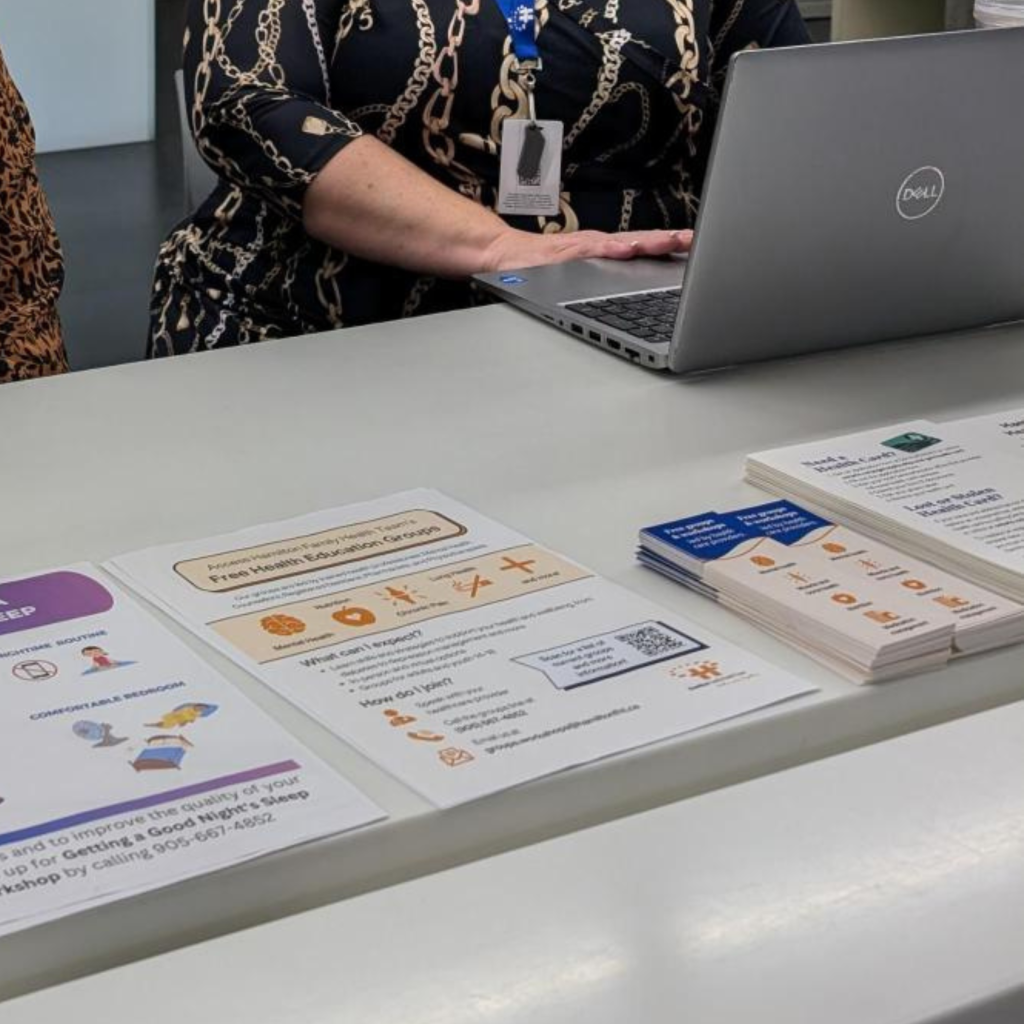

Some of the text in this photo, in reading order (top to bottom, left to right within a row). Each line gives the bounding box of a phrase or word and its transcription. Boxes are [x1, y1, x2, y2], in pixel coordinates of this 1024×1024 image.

[902, 184, 939, 201] DELL
[209, 525, 442, 584] Free Health Education Groups
[54, 629, 108, 647] ROUTINE
[299, 654, 339, 668] What
[339, 645, 365, 657] can
[372, 629, 424, 648] expect?
[29, 680, 187, 722] COMFORTABLE BEDROOM
[359, 696, 394, 708] How
[395, 688, 415, 700] do
[421, 677, 454, 693] join?
[2, 863, 29, 878] up
[30, 855, 59, 870] for
[61, 835, 135, 861] Getting
[134, 833, 146, 842] a
[147, 816, 197, 837] Good
[196, 801, 261, 824] Night's
[260, 789, 311, 808] Sleep
[11, 841, 47, 858] and
[48, 834, 70, 848] to
[72, 815, 146, 842] improve
[147, 806, 178, 821] the
[180, 788, 239, 813] quality
[242, 782, 261, 796] of
[261, 775, 301, 794] your
[62, 863, 88, 879] by
[91, 846, 155, 872] calling
[152, 811, 278, 855] 905-667-4852
